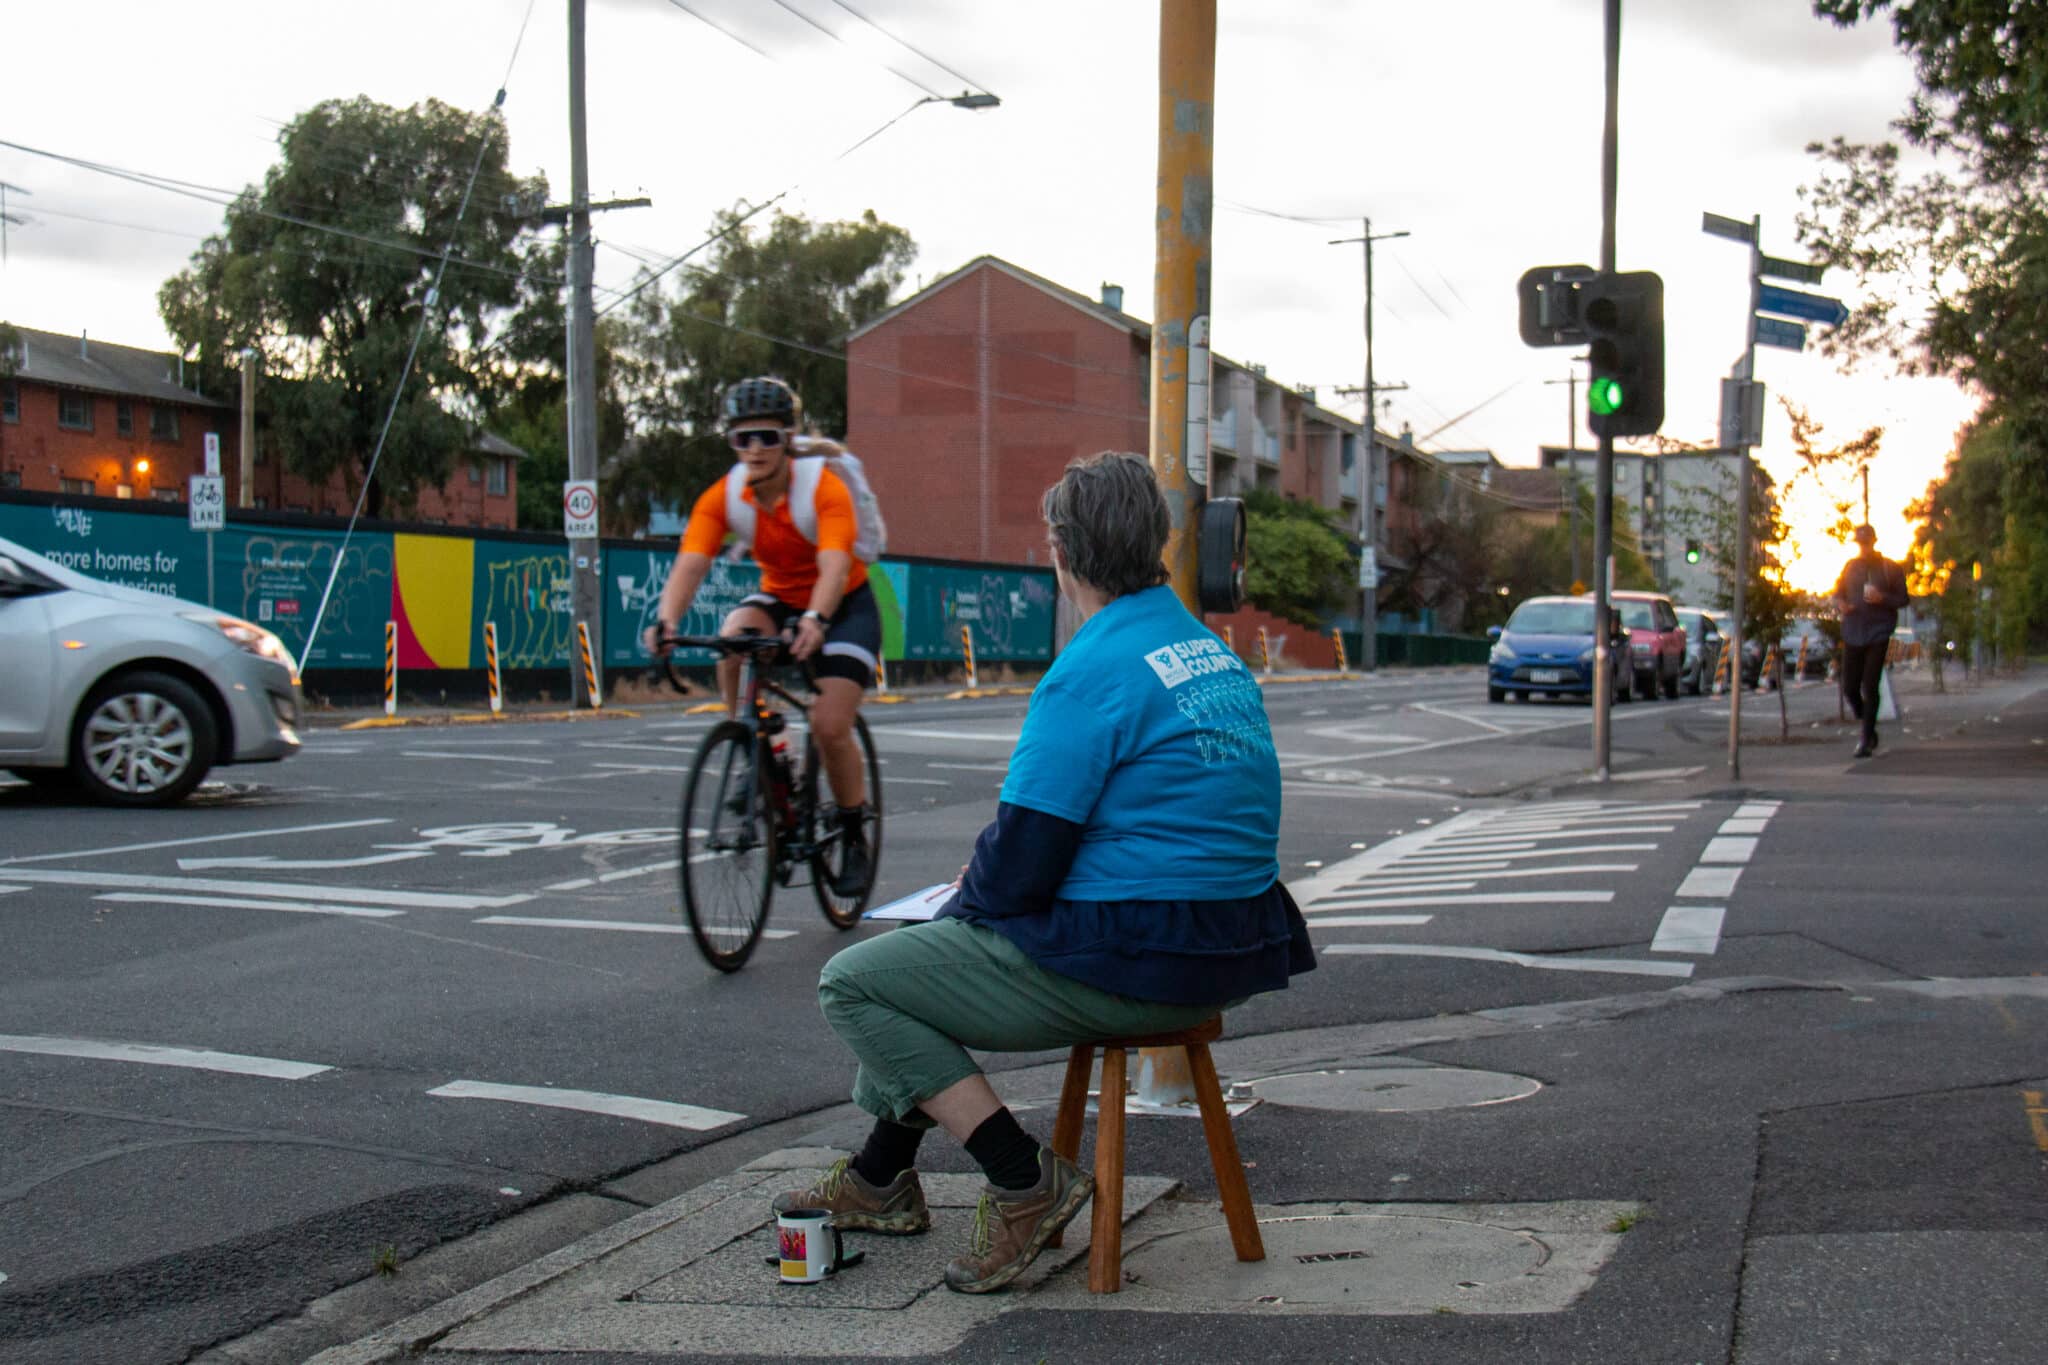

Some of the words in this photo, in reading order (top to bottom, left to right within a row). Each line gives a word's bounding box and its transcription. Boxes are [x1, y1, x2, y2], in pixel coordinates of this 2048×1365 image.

[571, 495, 590, 511] 40
[193, 511, 221, 523] LANE
[568, 523, 595, 533] AREA
[45, 551, 92, 570] more
[95, 548, 152, 572] homes
[155, 552, 179, 574] for
[1173, 638, 1223, 659] SUPER
[1186, 654, 1242, 676] COUNTS
